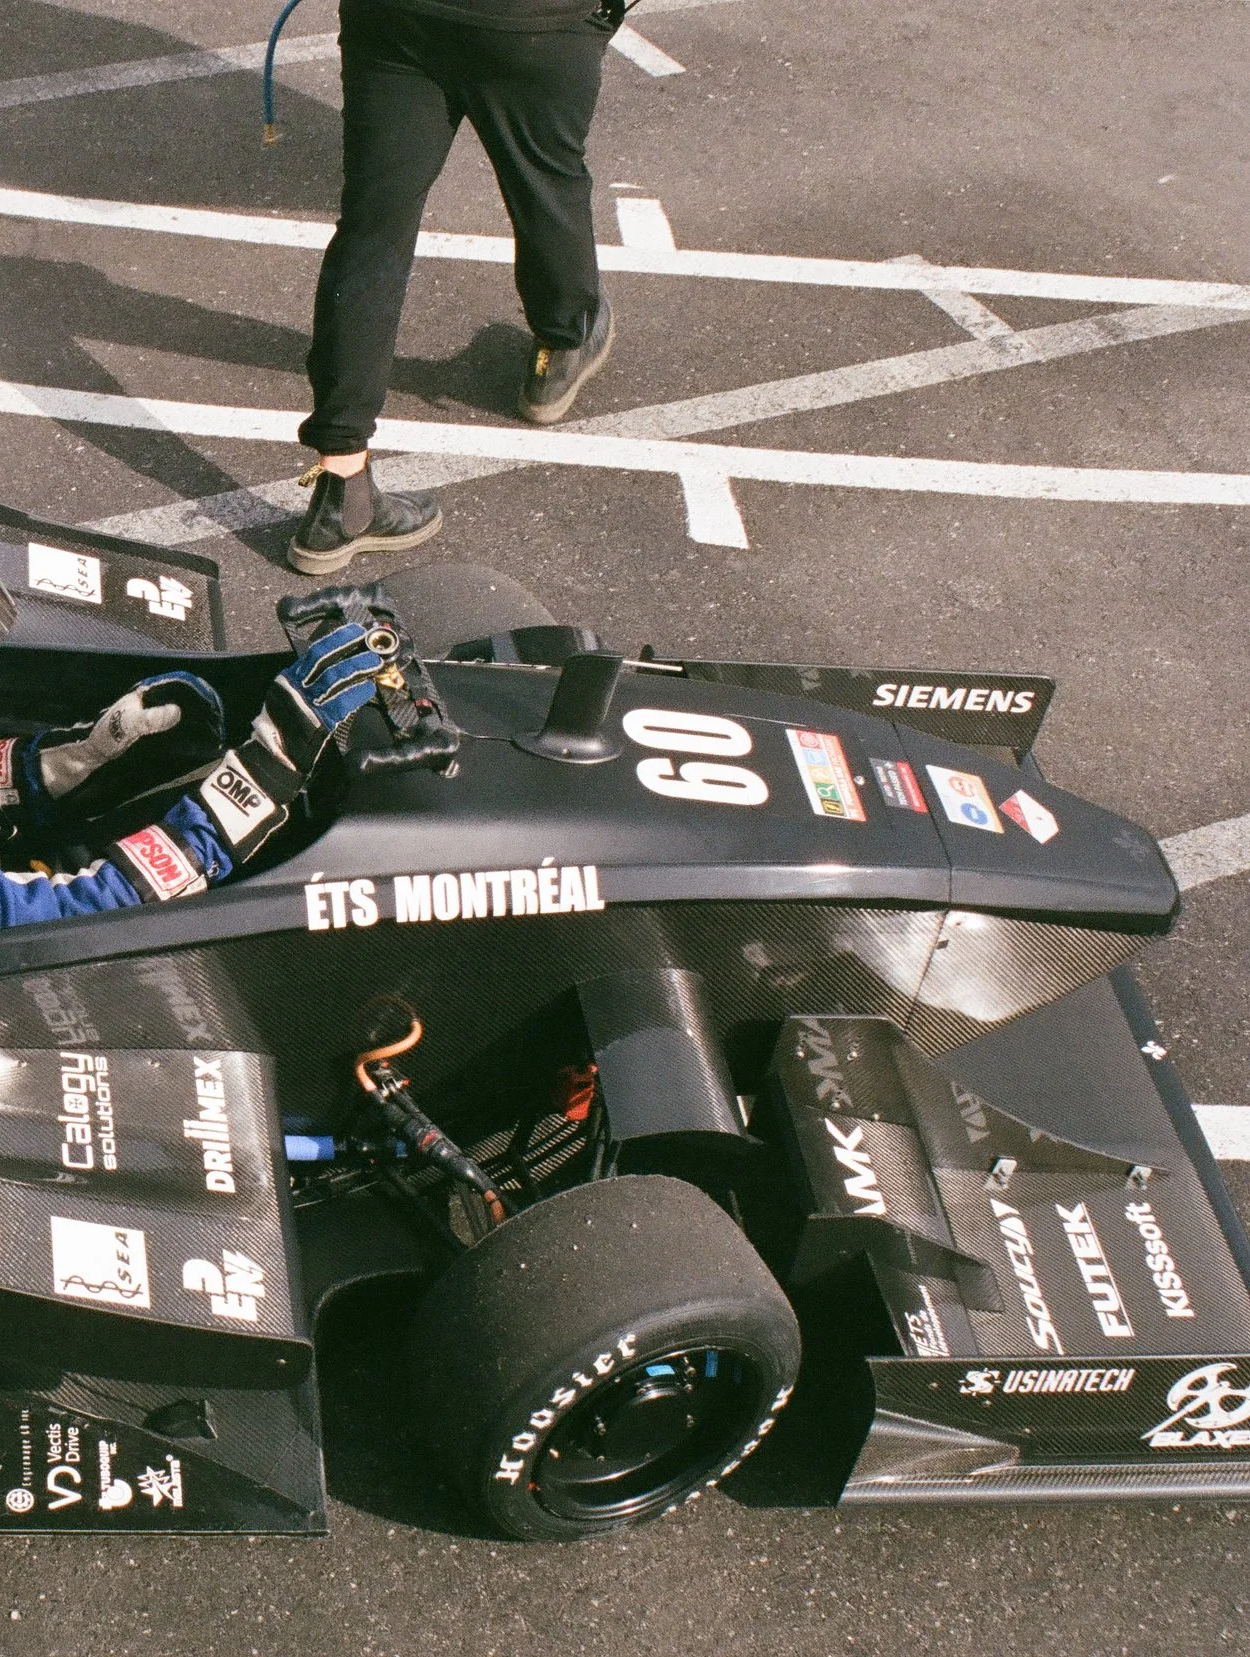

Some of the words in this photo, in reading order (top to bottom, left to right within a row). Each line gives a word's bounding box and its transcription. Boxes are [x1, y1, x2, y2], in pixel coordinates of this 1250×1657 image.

[873, 684, 1035, 713] SIEMENS
[623, 708, 769, 806] 60
[216, 771, 262, 809] OMP
[304, 872, 379, 931] ÉTS
[394, 857, 605, 923] MONTRÉAL
[1054, 1202, 1130, 1339] FUTEK
[1003, 1368, 1136, 1393] USINATECH
[46, 1422, 62, 1463] Vectis
[64, 1426, 81, 1463] Drive
